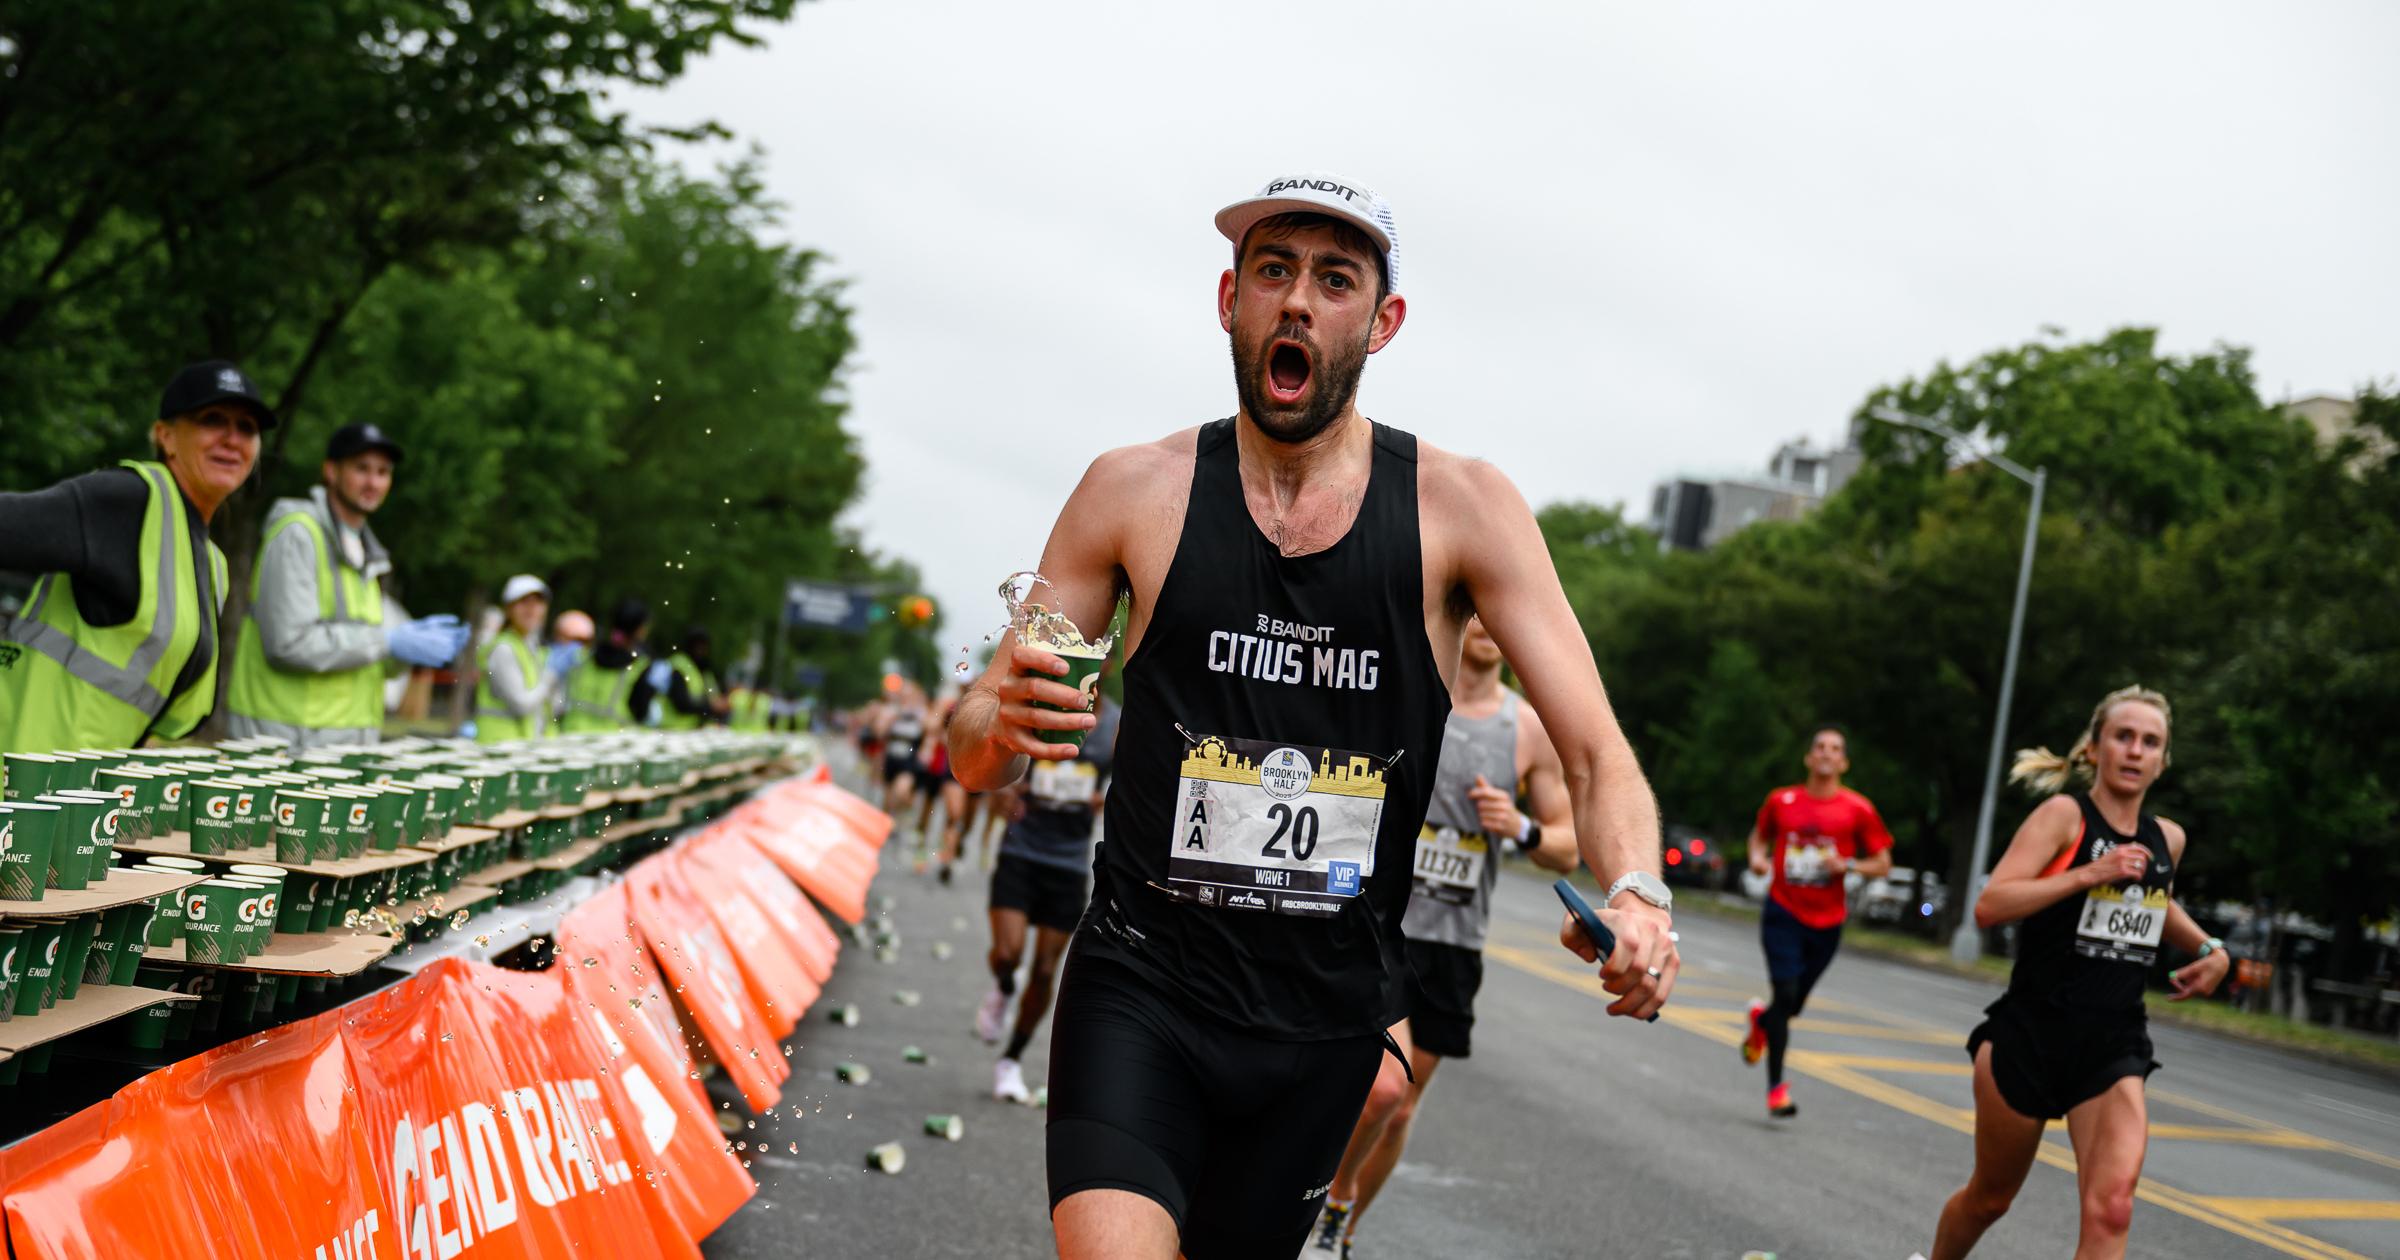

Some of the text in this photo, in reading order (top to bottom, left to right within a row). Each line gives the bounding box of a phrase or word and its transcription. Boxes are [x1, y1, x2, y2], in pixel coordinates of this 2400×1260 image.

[1267, 179, 1359, 201] BANDIT
[1270, 619, 1335, 642] BANDIT
[1207, 630, 1380, 691] CITIUS MAG
[1263, 766, 1309, 781] BROOKLYN
[1273, 778, 1296, 790] HALF
[1261, 802, 1319, 861] 20
[1255, 868, 1291, 887] WAVE 1
[1334, 880, 1354, 889] RUNNER
[1335, 866, 1355, 882] VIP
[187, 895, 207, 920] G
[2108, 908, 2153, 938] 6840
